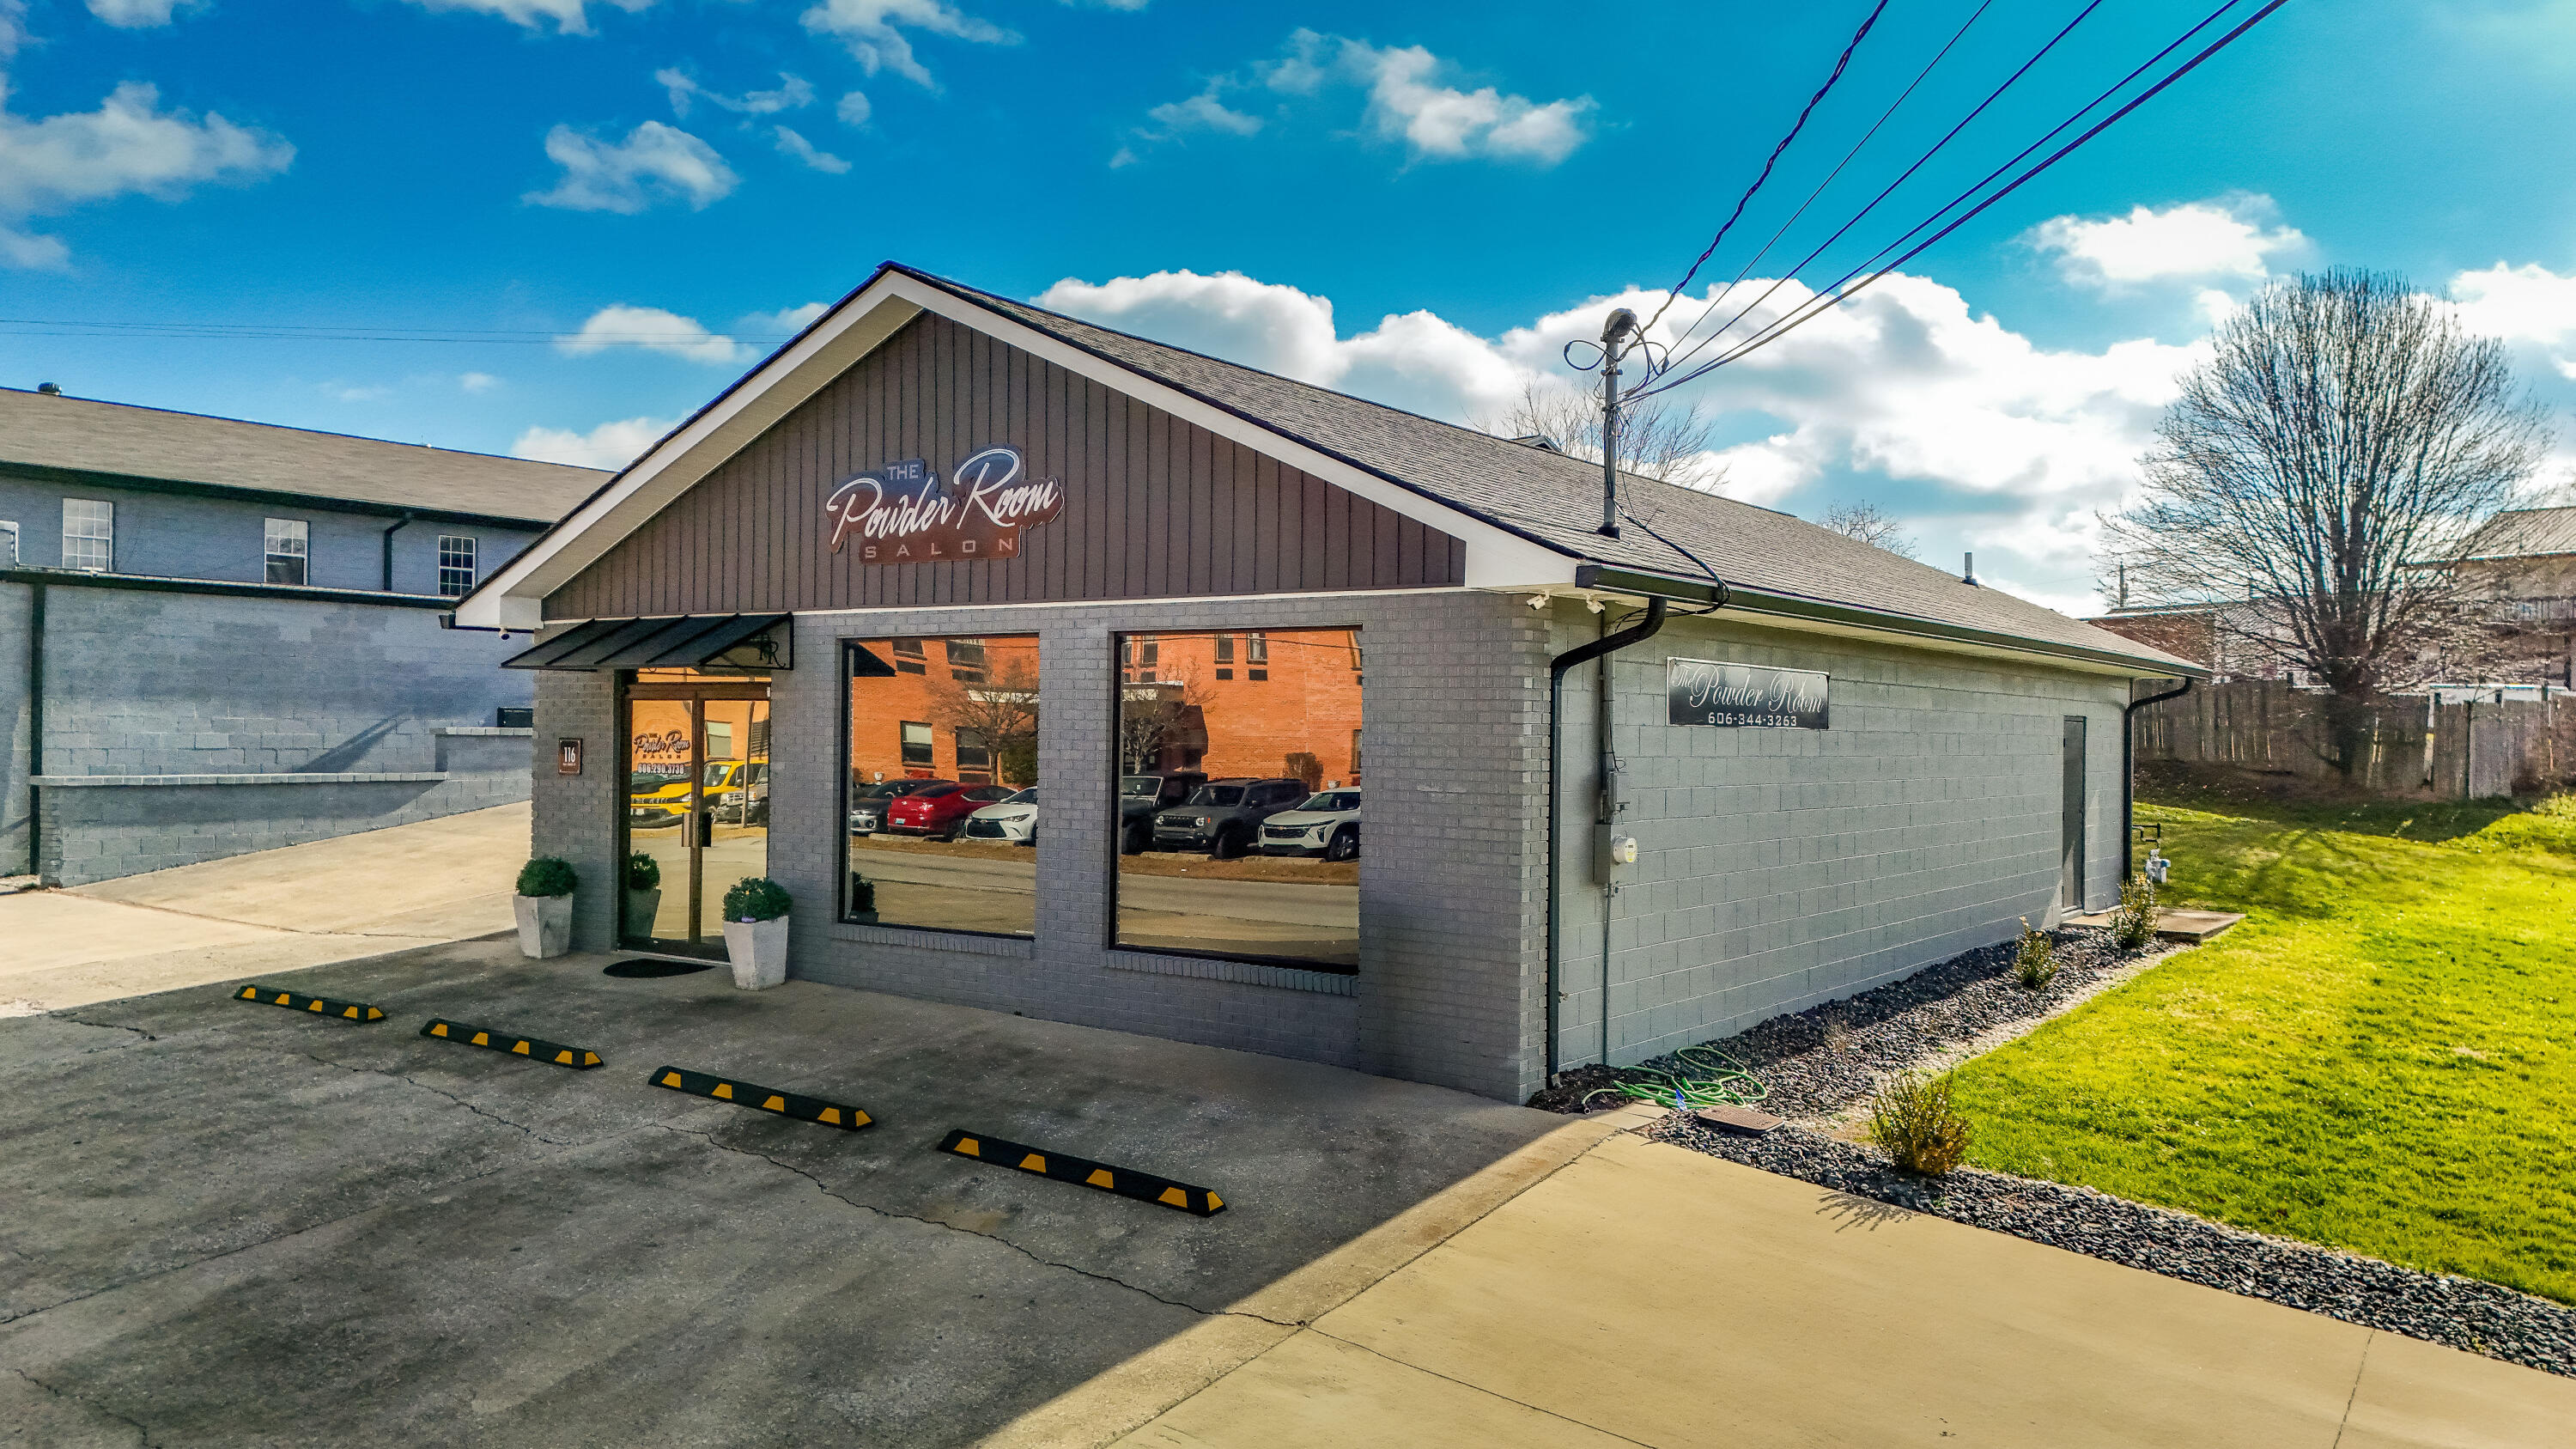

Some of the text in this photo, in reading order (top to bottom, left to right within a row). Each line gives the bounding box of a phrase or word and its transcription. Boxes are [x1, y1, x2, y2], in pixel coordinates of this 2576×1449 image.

[887, 464, 919, 480] THE
[826, 448, 1060, 545] Powder Room
[864, 537, 1013, 558] SALON
[1689, 664, 1764, 708] Powder
[1768, 671, 1825, 714] Room
[633, 729, 690, 754] Powder Room
[563, 746, 576, 763] 116
